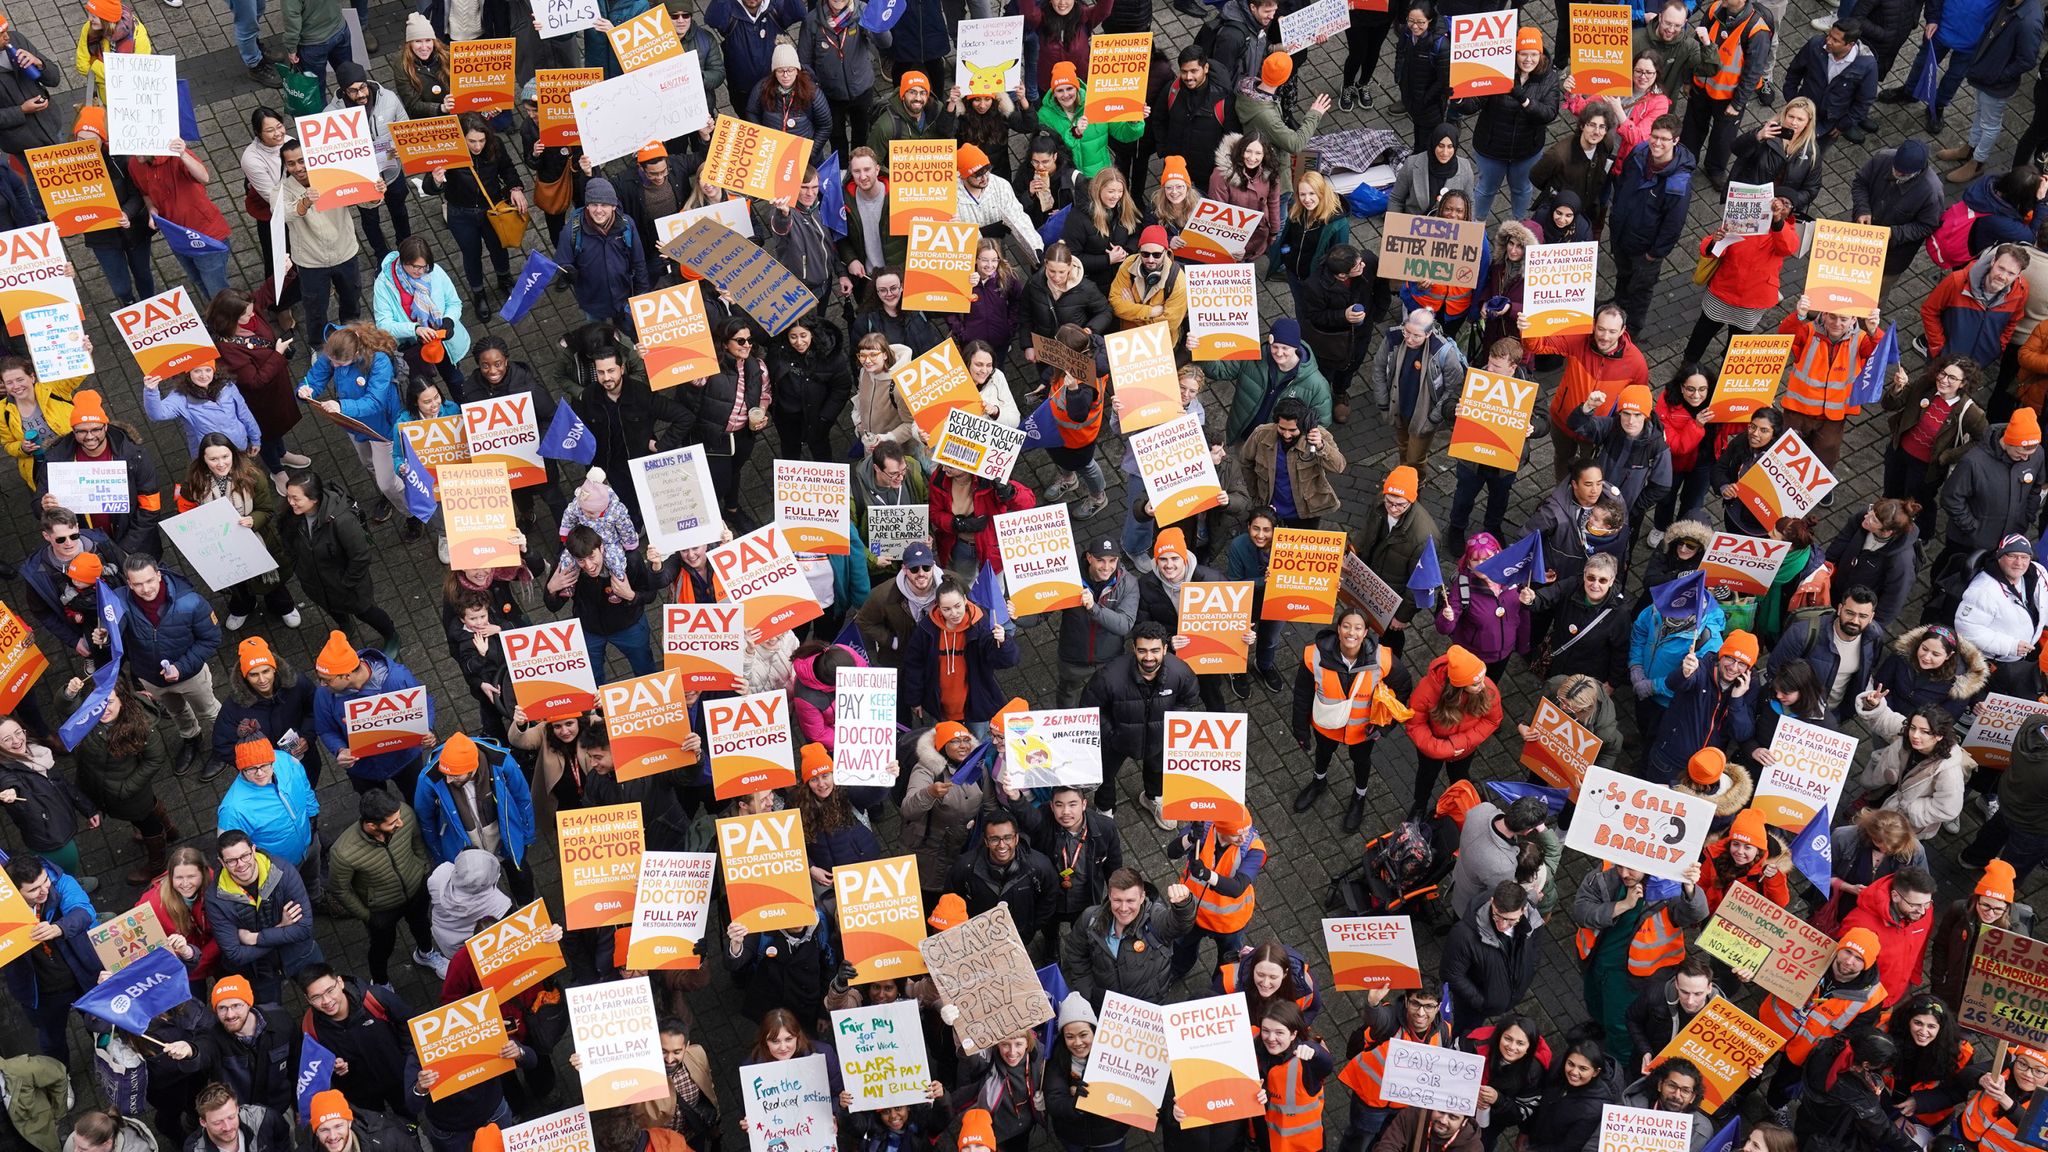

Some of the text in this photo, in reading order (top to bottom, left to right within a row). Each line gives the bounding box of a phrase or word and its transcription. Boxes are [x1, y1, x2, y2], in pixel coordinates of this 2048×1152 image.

[548, 6, 595, 29] BILLS
[1454, 15, 1512, 44] PAY
[1454, 41, 1498, 50] RESTORATION
[1454, 46, 1512, 61] DOCTORS
[300, 112, 360, 148] PAY
[114, 137, 171, 151] AUSTRALI
[308, 146, 370, 167] DOCTORS
[912, 226, 974, 253] PAY
[1410, 217, 1460, 241] RISH
[1386, 235, 1478, 263] BETTER HAVE MY
[704, 262, 724, 279] NHS
[909, 259, 971, 271] DOCTORS
[1189, 270, 1240, 278] £14/HOUR
[1404, 257, 1455, 282] MONEY
[1190, 287, 1208, 295] FOR
[1219, 286, 1252, 294] JUNIOR
[1191, 295, 1253, 307] DOCTOR
[117, 292, 182, 335] PAY
[1198, 312, 1248, 321] FULL PAY
[130, 318, 198, 350] DOCTORS
[1466, 374, 1533, 410] PAY
[949, 410, 1025, 446] REDUCED TO CLEAR
[1461, 407, 1525, 430] DOCTORS
[948, 423, 1014, 453] DOCTORS NOW
[644, 452, 693, 472] BARCLAYS PLAN
[984, 464, 1006, 478] OFF!
[103, 503, 128, 512] NHS
[908, 508, 916, 516] A
[679, 519, 697, 531] NHS
[869, 516, 904, 525] REASON
[869, 523, 923, 532] JUNIOR DRS
[505, 624, 575, 660] PAY
[512, 658, 585, 679] DOCTORS
[836, 672, 897, 690] INADEQUATE
[838, 693, 896, 720] PAY KEEPS
[870, 708, 893, 721] THE
[1063, 714, 1078, 725] PAY
[838, 725, 893, 746] DOCTOR
[1168, 719, 1242, 749] PAY
[1167, 759, 1241, 771] DOCTORS
[90, 906, 155, 946] RESTORE
[1331, 922, 1405, 933] OFFICIAL
[1726, 901, 1789, 939] JUNIOR DOCTORS
[1731, 886, 1832, 950] REDUCED TO CLEAR
[114, 925, 145, 947] OUR
[928, 908, 1011, 969] CLAPS
[1341, 931, 1398, 942] PICKET
[1717, 919, 1762, 949] REDUCED
[118, 935, 148, 958] PAY
[1708, 938, 1729, 955] NOW
[1778, 939, 1825, 969] 30%
[936, 942, 1017, 999] DON'T
[1776, 957, 1809, 981] OFF
[125, 972, 172, 999] BMA
[222, 984, 238, 993] BMA
[953, 974, 1013, 1025] PAY
[414, 995, 487, 1046] PAY
[839, 1017, 865, 1035] Fair
[965, 994, 1044, 1050] BILLS
[1170, 1003, 1242, 1028] OFFICIAL
[856, 1032, 876, 1045] for
[1180, 1019, 1236, 1041] PICKET
[423, 1024, 500, 1062] DOCTORS
[876, 1041, 899, 1051] Work
[845, 1055, 895, 1075] CLAPS
[900, 1064, 922, 1077] PAY
[1393, 1047, 1478, 1081] PAY US
[753, 1076, 802, 1101] From the
[863, 1079, 929, 1098] MY BILLS
[1416, 1072, 1441, 1088] OR
[1215, 1098, 1235, 1109] BMA
[1389, 1082, 1471, 1111] LOSE US
[772, 1115, 784, 1125] to
[764, 1122, 811, 1141] Australia
